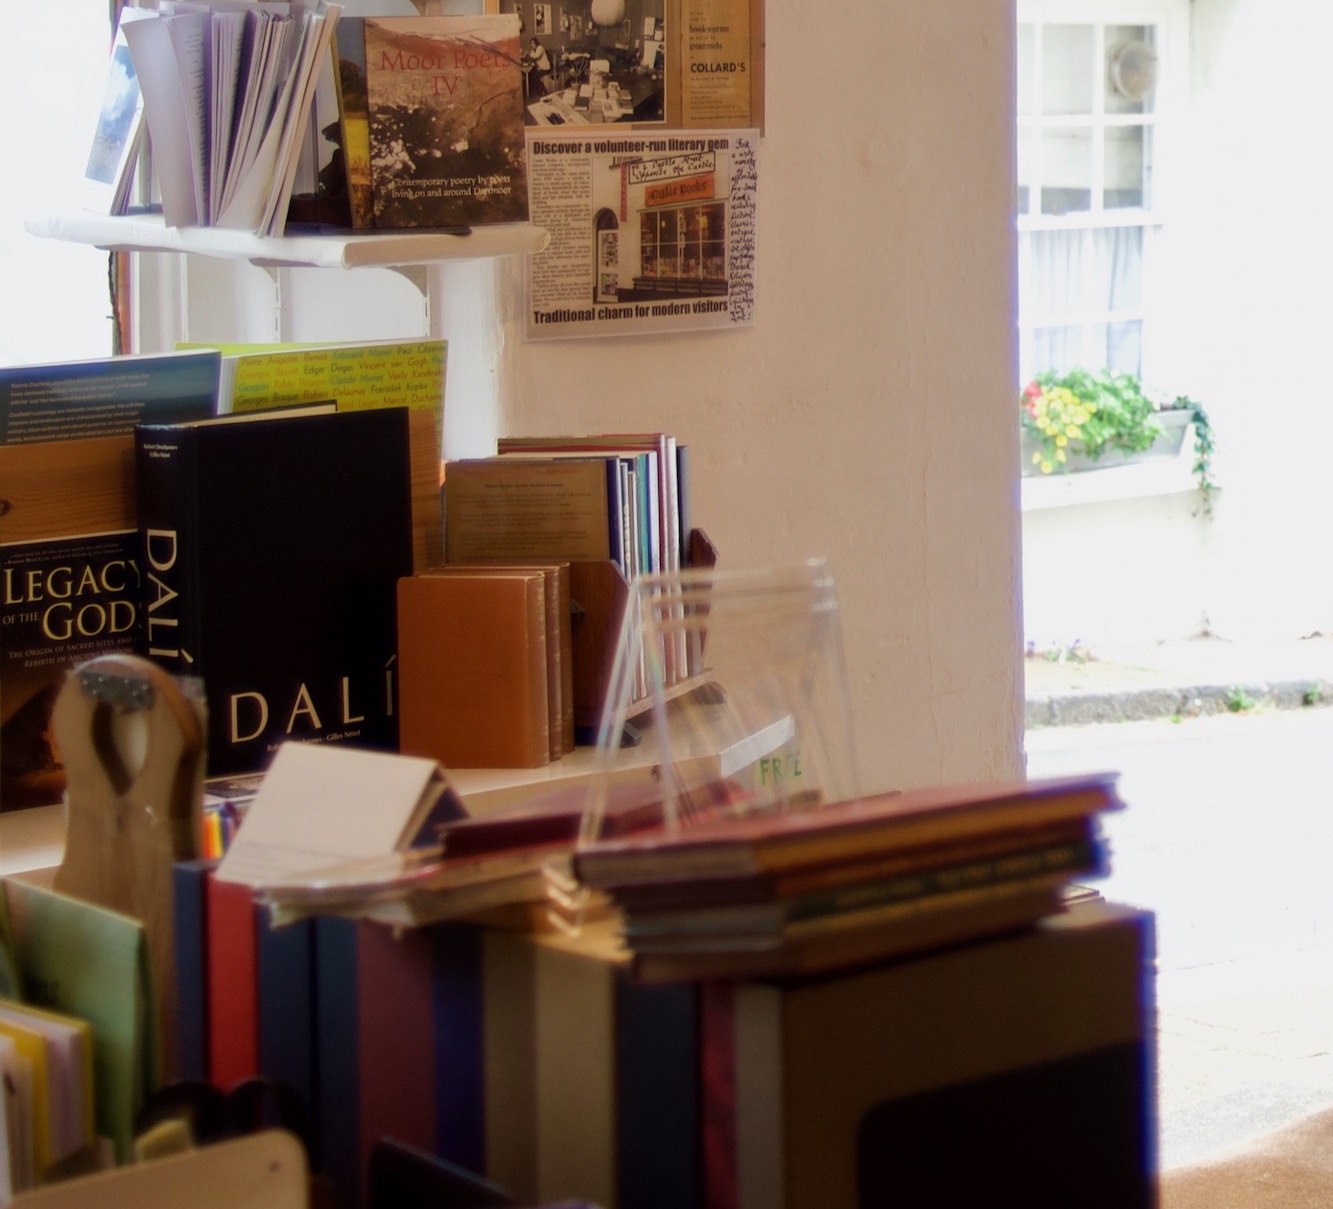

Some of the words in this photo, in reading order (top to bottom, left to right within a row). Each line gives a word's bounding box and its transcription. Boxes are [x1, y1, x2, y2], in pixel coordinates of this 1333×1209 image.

[689, 24, 729, 33] bookworms
[689, 42, 722, 51] gourmets
[382, 50, 445, 71] Moor
[454, 49, 511, 69] Poets
[690, 62, 746, 73] COLLARD'S
[432, 76, 460, 96] IV
[533, 141, 583, 154] Discover
[585, 143, 592, 154] a
[594, 139, 667, 153] volunteer-run
[668, 138, 706, 153] literary
[707, 138, 729, 153] gem
[392, 178, 448, 188] Contemporary
[451, 177, 476, 187] poetry
[478, 176, 488, 185] by
[489, 176, 511, 185] poets
[392, 188, 411, 198] living
[415, 190, 426, 198] on
[427, 188, 442, 197] and
[444, 187, 471, 196] around
[534, 309, 596, 324] Traditional
[598, 305, 631, 320] charm
[635, 304, 650, 318] for
[652, 302, 691, 317] modern
[692, 299, 728, 314] visitors
[304, 365, 325, 375] Edgar
[331, 363, 353, 374] Degas
[359, 361, 385, 370] Vincent
[408, 357, 428, 369] Gogh
[146, 528, 194, 664] DALÍ
[2, 613, 16, 625] OF
[19, 611, 39, 624] THE
[42, 600, 143, 641] GOD
[230, 654, 397, 744] DALÍ
